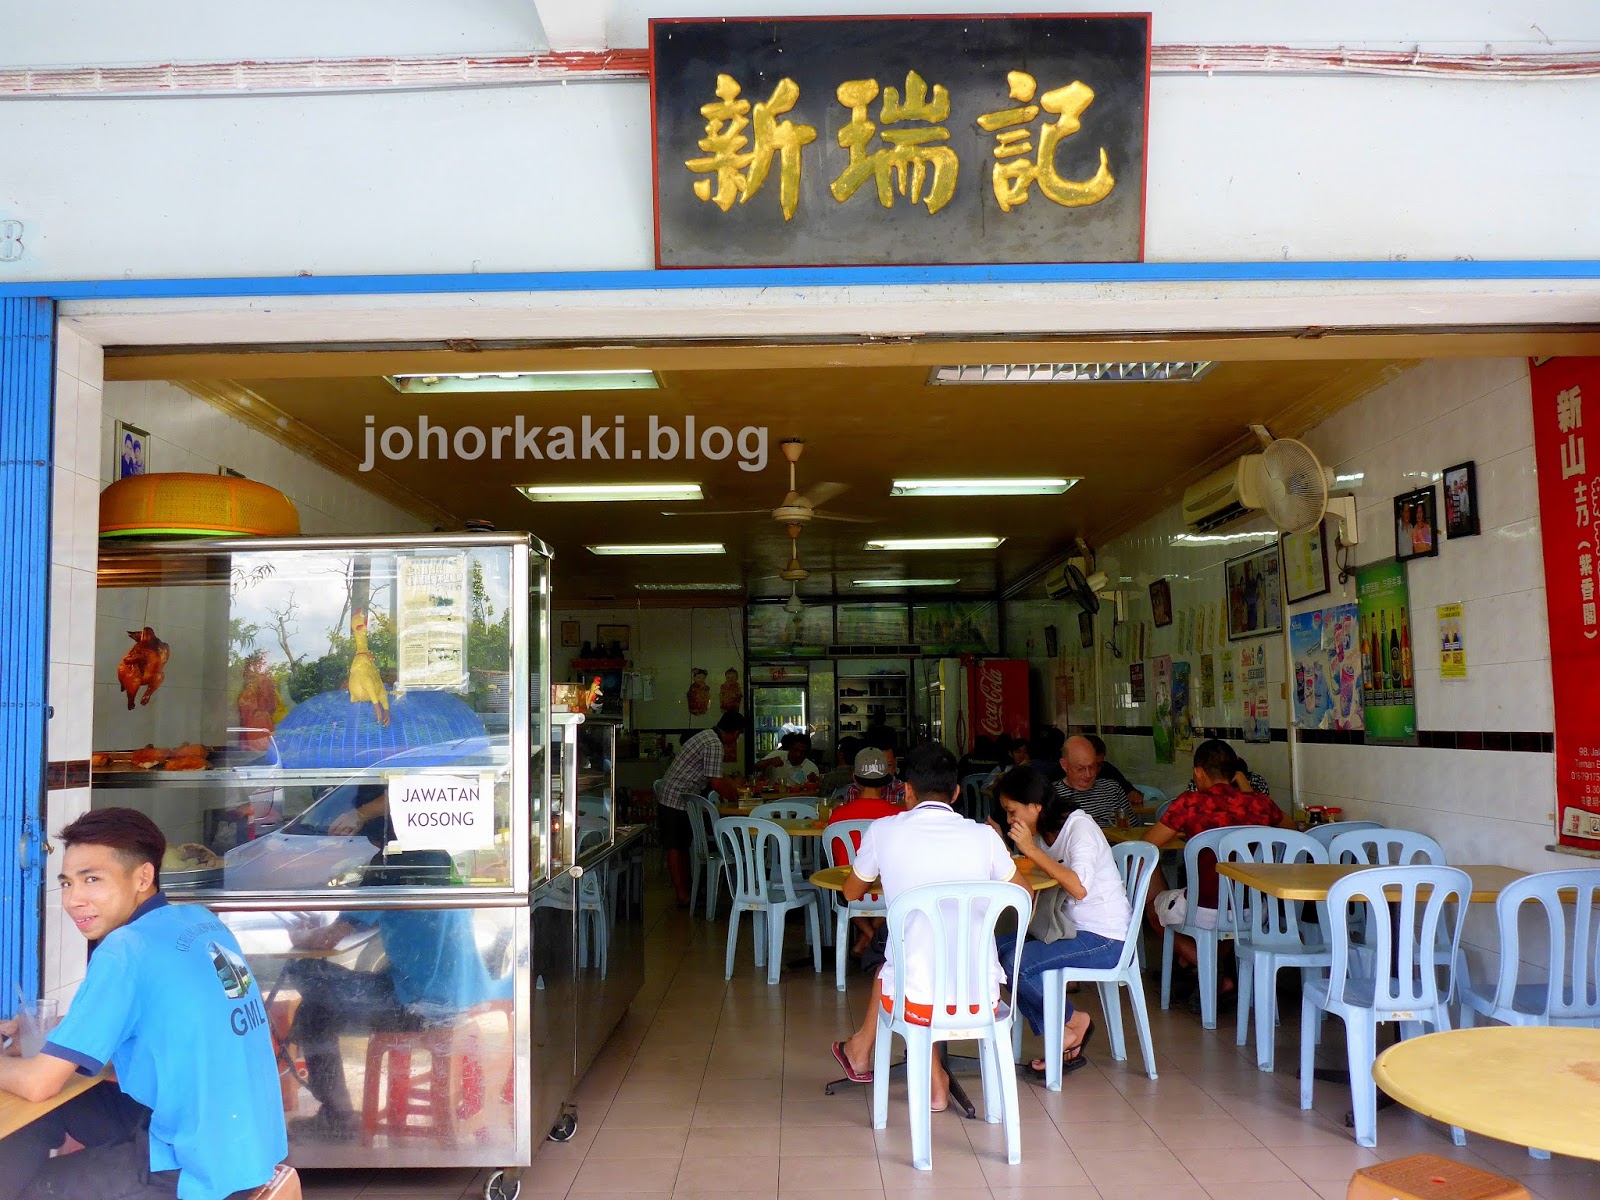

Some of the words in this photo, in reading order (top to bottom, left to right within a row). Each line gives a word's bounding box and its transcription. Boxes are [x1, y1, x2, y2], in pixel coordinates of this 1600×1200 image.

[685, 70, 1115, 221] 新瑞記
[401, 787, 480, 803] JAWATAN
[407, 811, 474, 827] KOSONG
[230, 998, 266, 1036] GML
